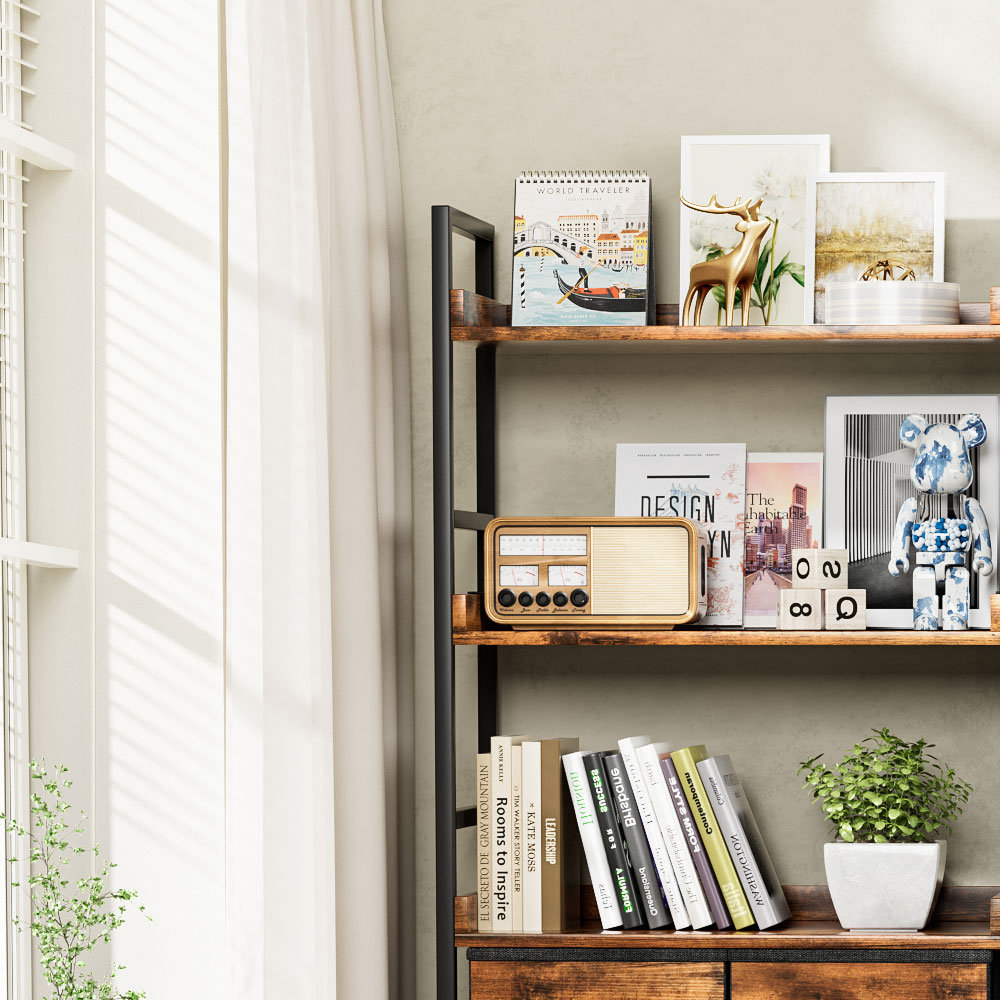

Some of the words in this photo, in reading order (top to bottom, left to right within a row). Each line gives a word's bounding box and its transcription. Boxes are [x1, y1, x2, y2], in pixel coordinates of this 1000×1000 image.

[537, 188, 574, 196] WORLD
[580, 186, 630, 194] TRAVELER
[641, 496, 715, 523] DESIGN
[746, 493, 774, 506] The
[836, 596, 858, 622] Q
[480, 765, 489, 820] MOUNTAIN
[480, 822, 489, 848] GRAY
[497, 797, 508, 846] Rooms
[527, 812, 536, 840] KATE
[545, 818, 556, 865] LEADERSHIP
[480, 852, 489, 866] DE
[497, 851, 508, 866] to
[527, 843, 536, 873] MOSS
[480, 868, 490, 909] SECRETO
[494, 871, 510, 921] Inspire
[482, 912, 490, 922] EL
